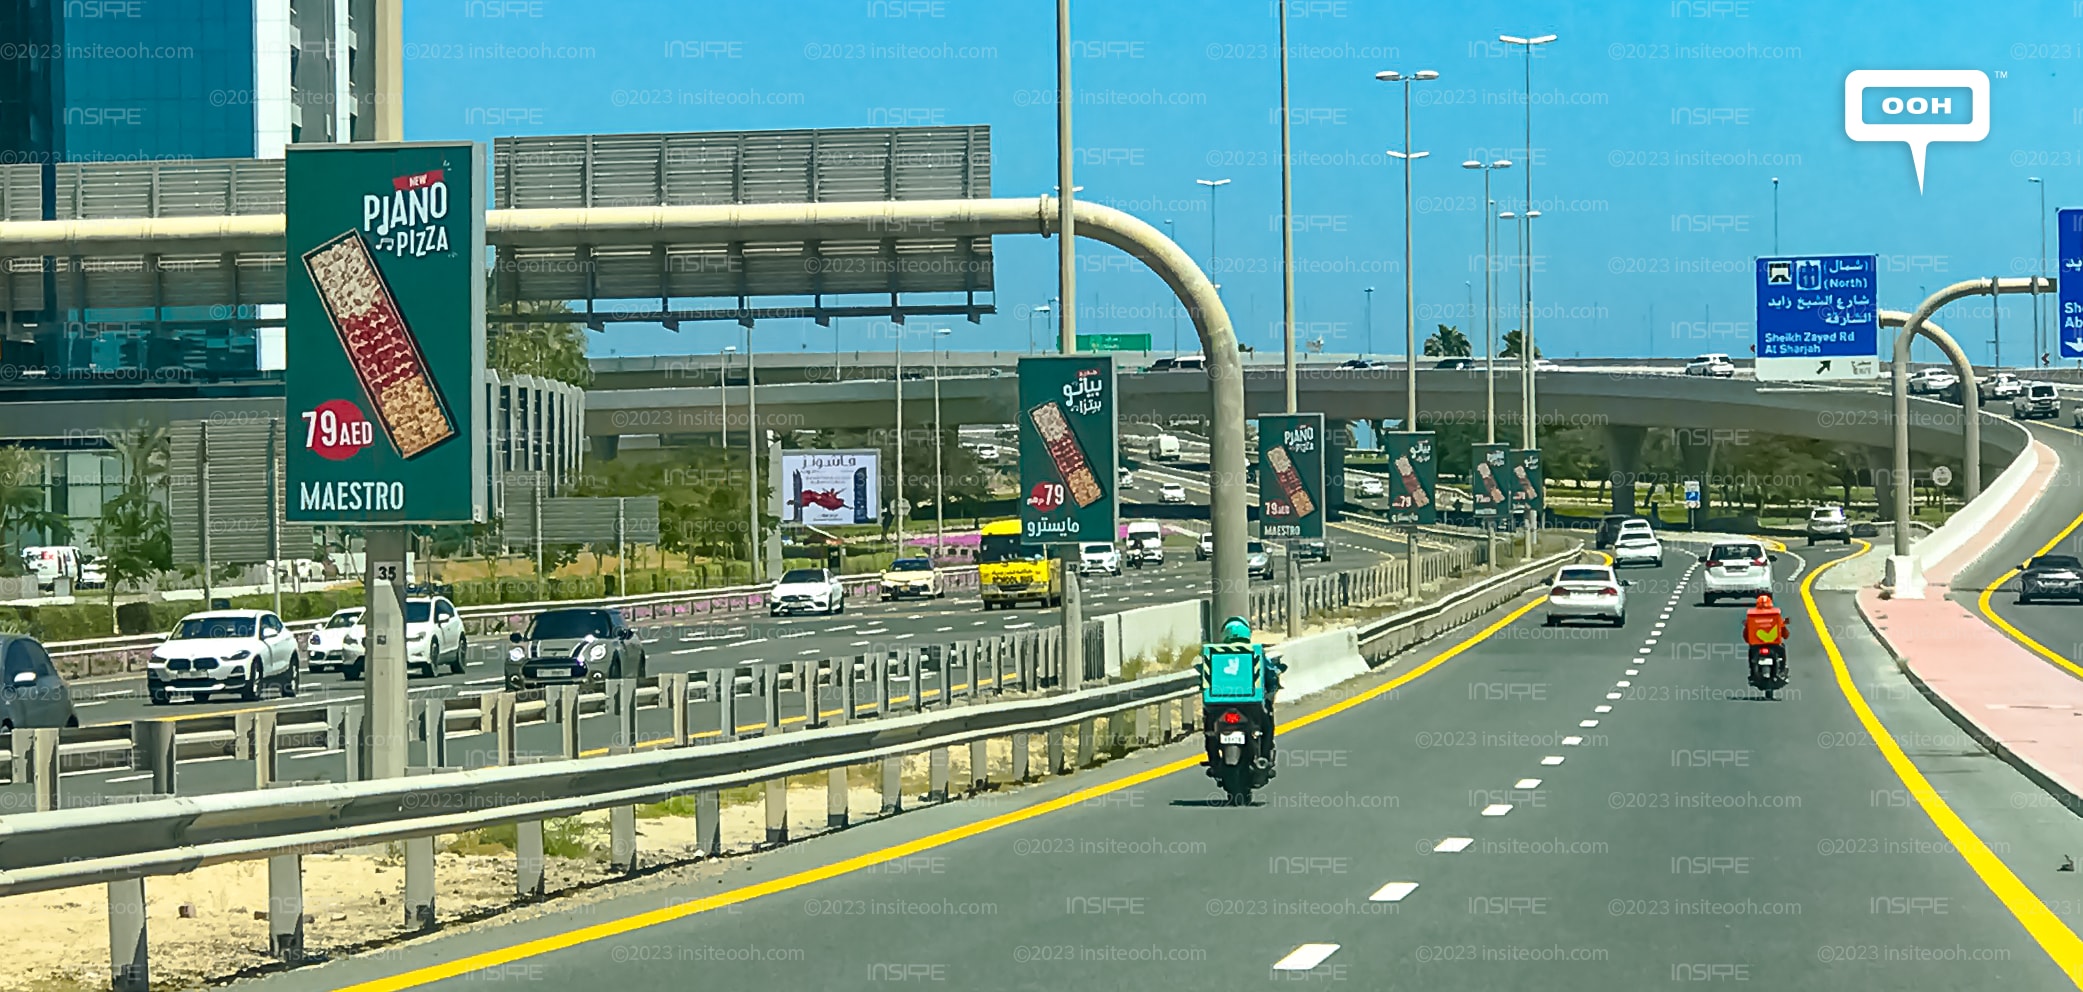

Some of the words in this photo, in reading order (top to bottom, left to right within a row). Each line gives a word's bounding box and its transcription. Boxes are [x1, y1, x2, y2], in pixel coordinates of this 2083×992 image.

[409, 174, 427, 187] NEW
[397, 225, 449, 256] PIZZA
[1824, 278, 1868, 289] (North)
[1765, 333, 1802, 343] Sheikh
[1803, 332, 1837, 344] Zayed
[1839, 332, 1855, 342] Rd
[1779, 344, 1821, 355] Sharjah
[1063, 377, 1102, 407] بيانو
[1079, 398, 1102, 416] بيتزا
[300, 482, 404, 510] MAESTRO
[1027, 516, 1080, 537] مايسترو
[378, 566, 397, 581] 35
